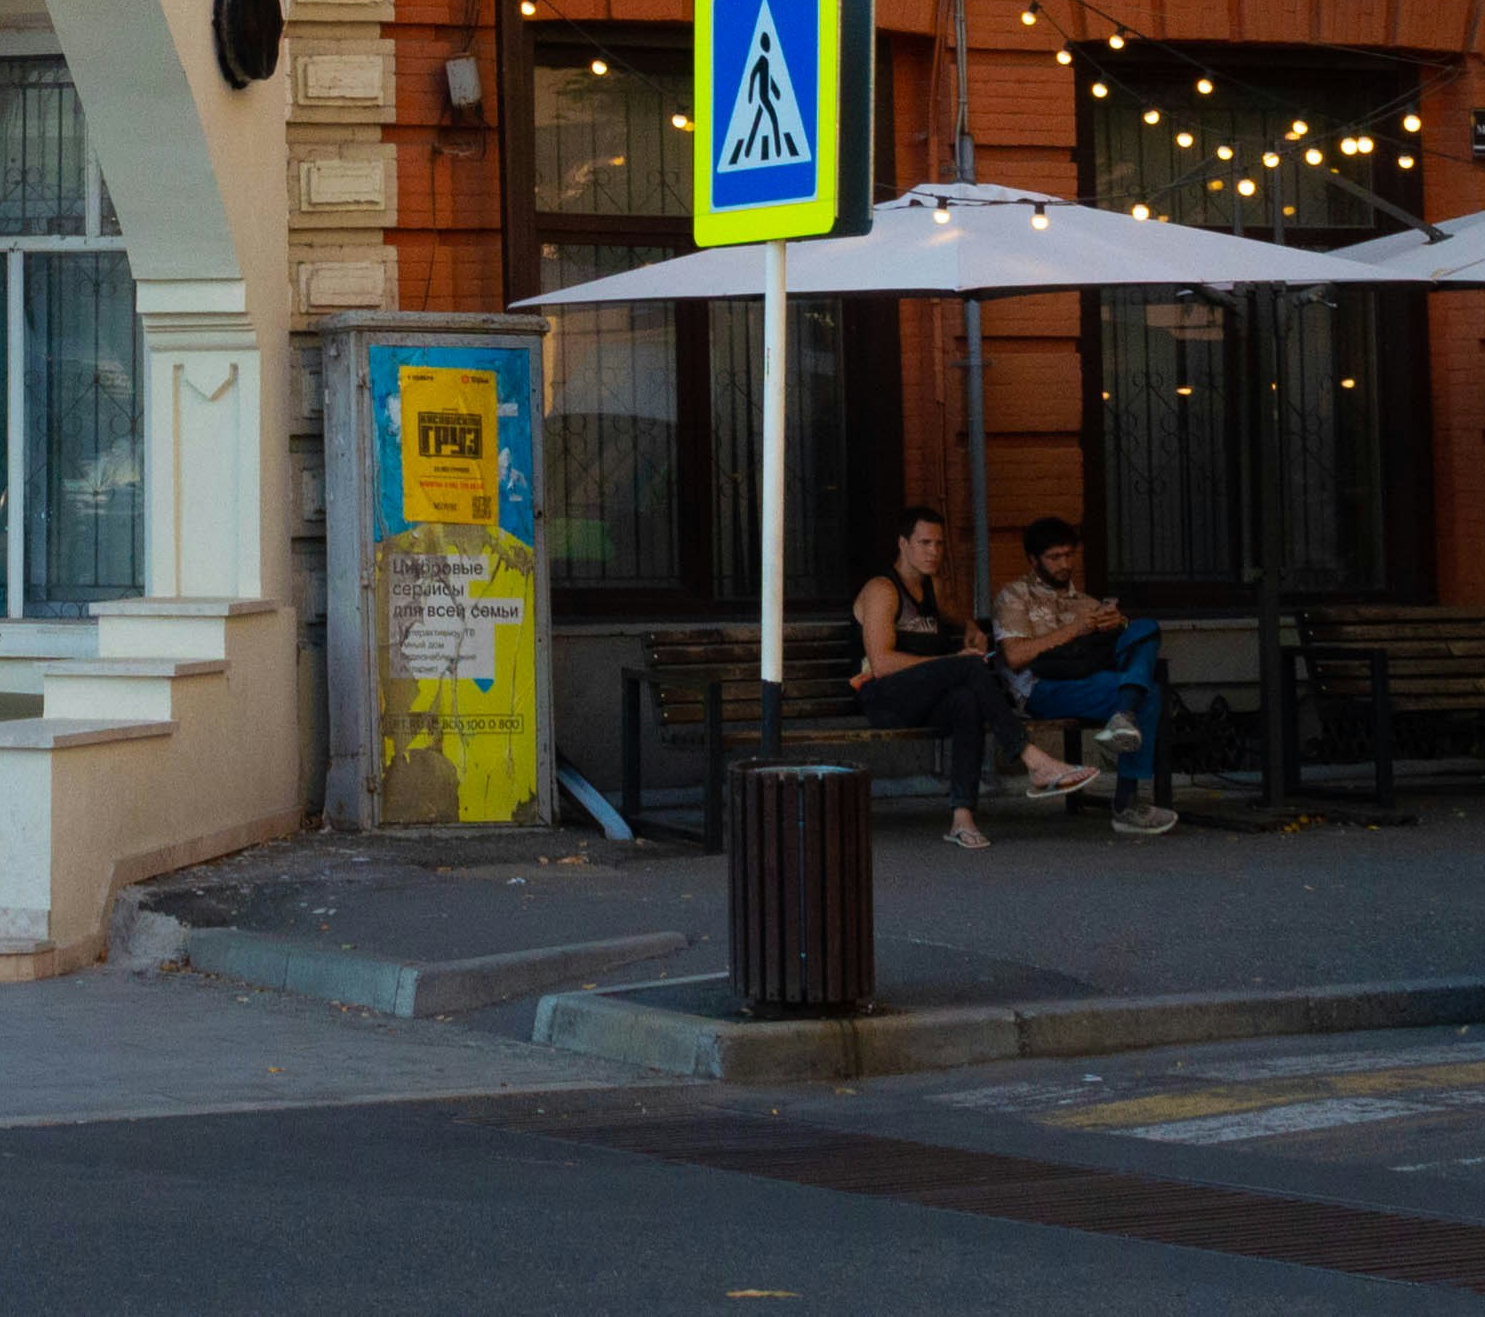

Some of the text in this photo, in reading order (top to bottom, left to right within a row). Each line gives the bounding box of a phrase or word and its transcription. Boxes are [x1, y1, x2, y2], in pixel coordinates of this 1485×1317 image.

[421, 427, 480, 456] ГРУЗ
[393, 606, 423, 619] для
[471, 605, 519, 618] семьи
[499, 718, 520, 729] 800
